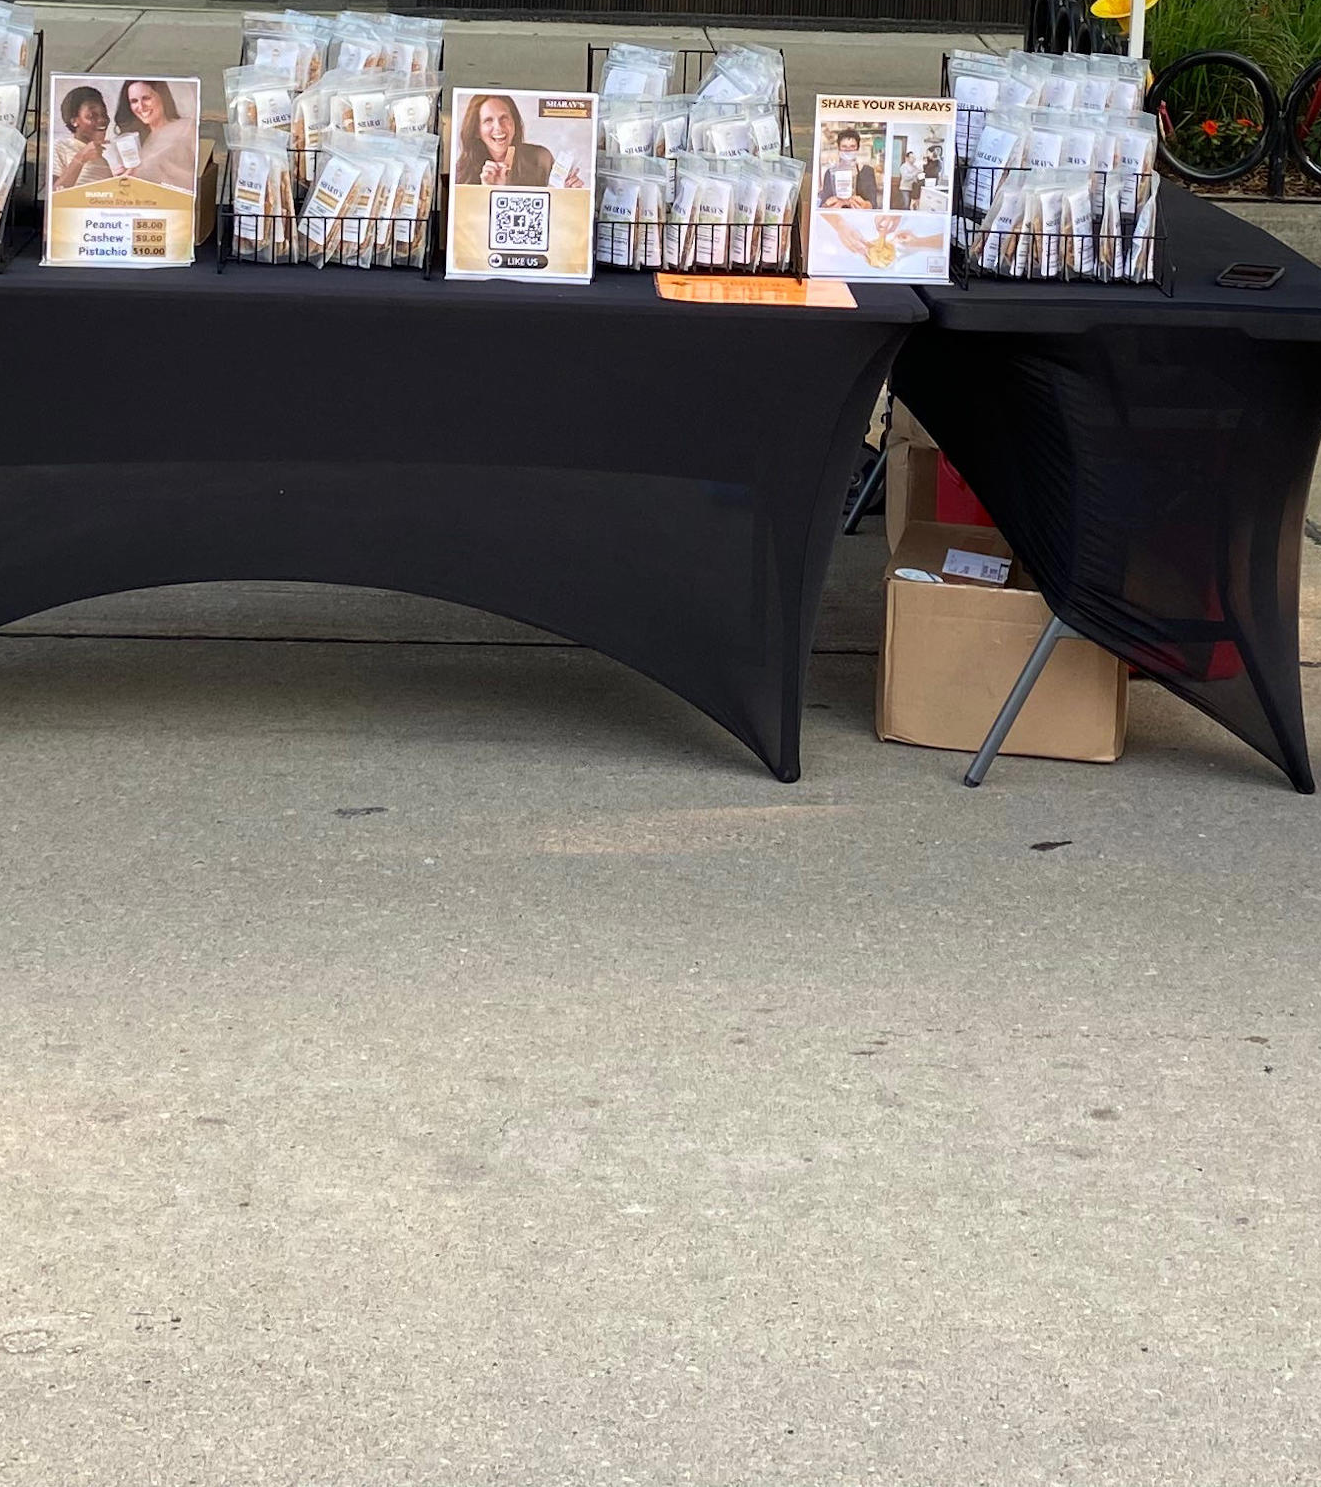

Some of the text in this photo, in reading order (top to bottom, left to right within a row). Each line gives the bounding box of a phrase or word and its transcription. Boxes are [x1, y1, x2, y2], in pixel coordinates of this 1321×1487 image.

[821, 99, 952, 113] SHARE YOUR SHARAYS
[85, 220, 122, 230] Peanut
[136, 221, 163, 229] $8.00
[83, 233, 124, 243] Cashew
[78, 246, 165, 256] Pistachio $10.00
[507, 256, 539, 267] LIKE US
